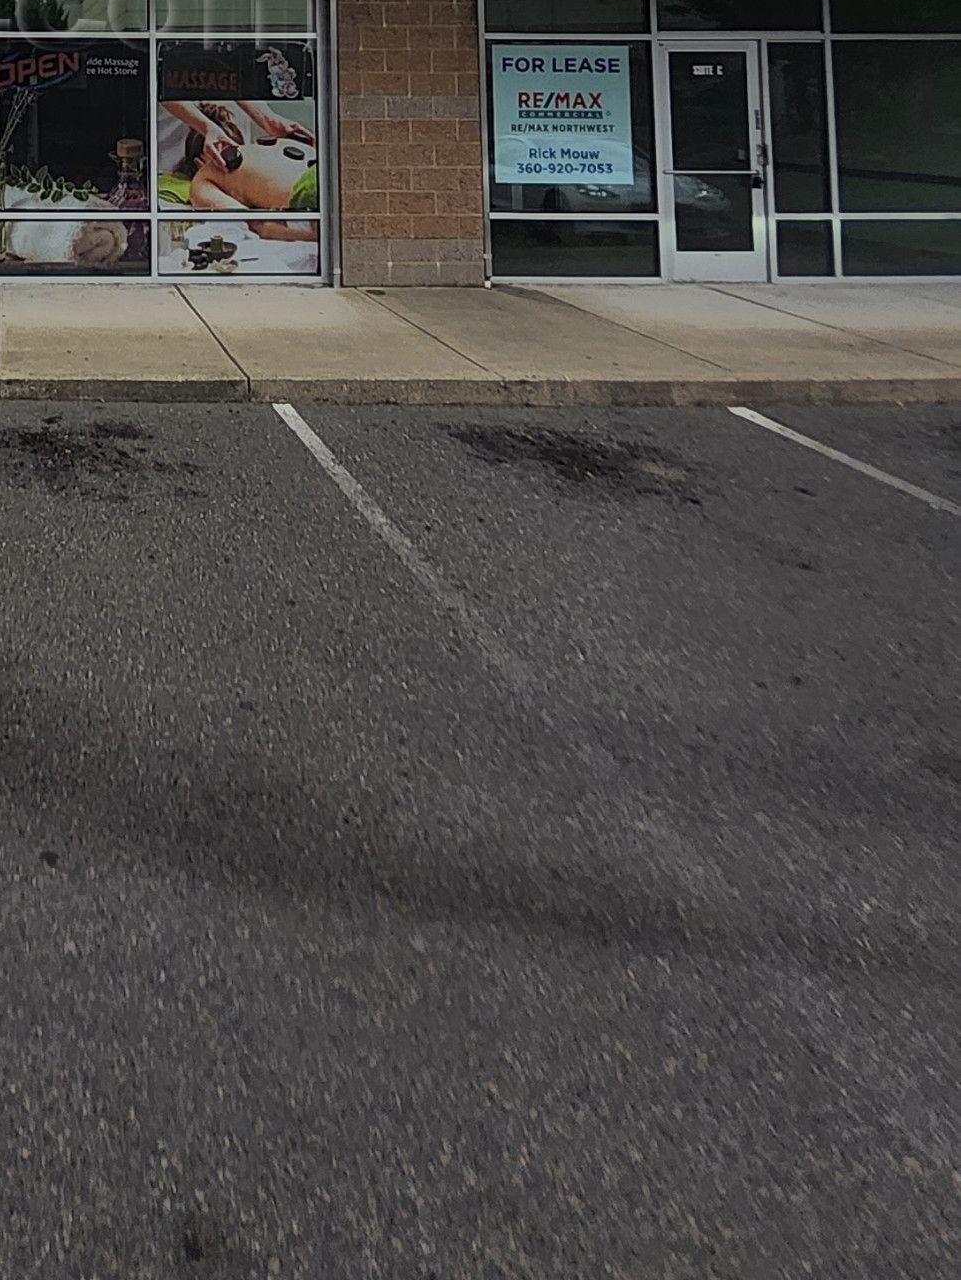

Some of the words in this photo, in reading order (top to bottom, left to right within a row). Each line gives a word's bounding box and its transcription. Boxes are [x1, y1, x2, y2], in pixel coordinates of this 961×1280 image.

[104, 57, 139, 68] Massage
[502, 57, 545, 73] FOR
[552, 57, 621, 74] LEASE
[97, 66, 113, 75] Hot
[114, 66, 138, 76] Stone
[166, 70, 238, 91] MASSAGE
[518, 92, 603, 109] RE/MAX
[511, 124, 550, 133] RE/MAX
[552, 124, 615, 133] NORTHWEST
[529, 147, 557, 159] Rick
[560, 148, 600, 159] Mouw
[517, 163, 614, 174] 360-920-7053
